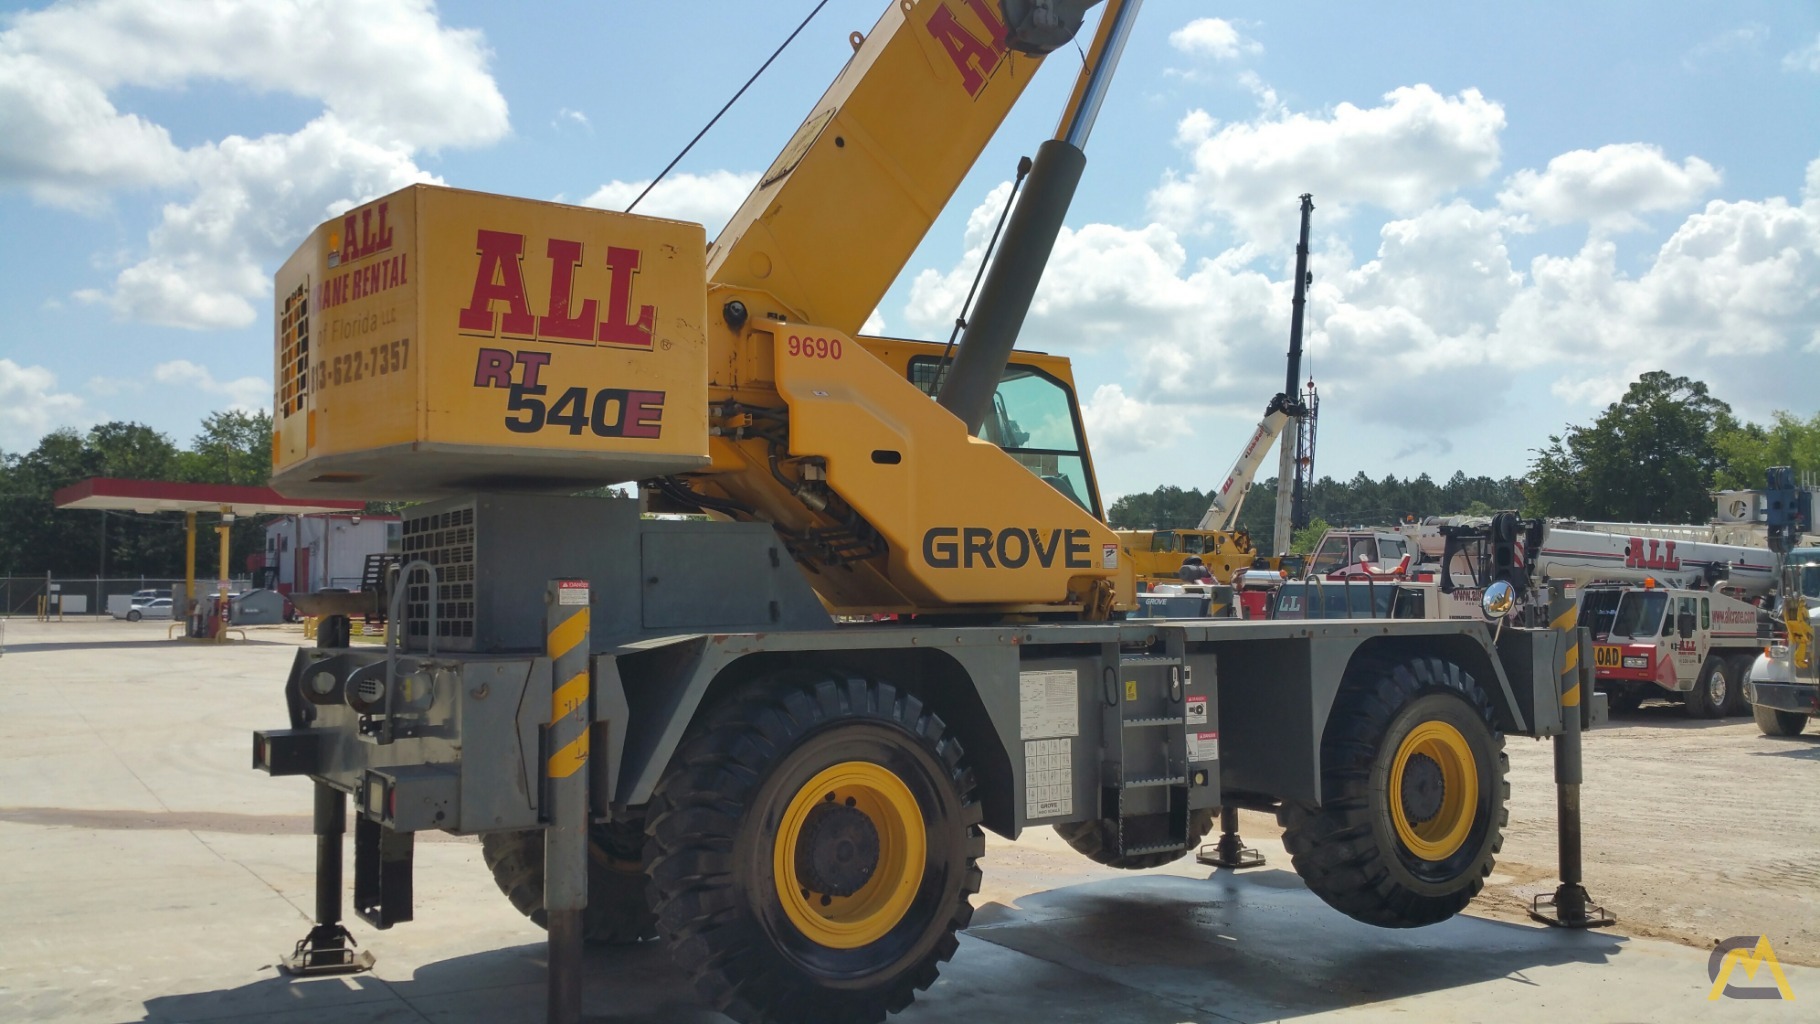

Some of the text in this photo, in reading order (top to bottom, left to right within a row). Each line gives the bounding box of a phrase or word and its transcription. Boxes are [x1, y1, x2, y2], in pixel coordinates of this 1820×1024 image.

[926, 0, 1008, 99] AL
[340, 201, 394, 264] ALL
[352, 252, 408, 301] RENTAL
[458, 229, 657, 351] ALL
[317, 323, 328, 347] of
[332, 313, 378, 342] Florida
[787, 335, 842, 361] 9690
[474, 348, 552, 389] RT
[504, 382, 666, 439] 540E
[922, 526, 1092, 569] GROVE
[1626, 537, 1680, 571] ALL
[1145, 598, 1168, 606] GROVE
[1594, 647, 1619, 666] OAD
